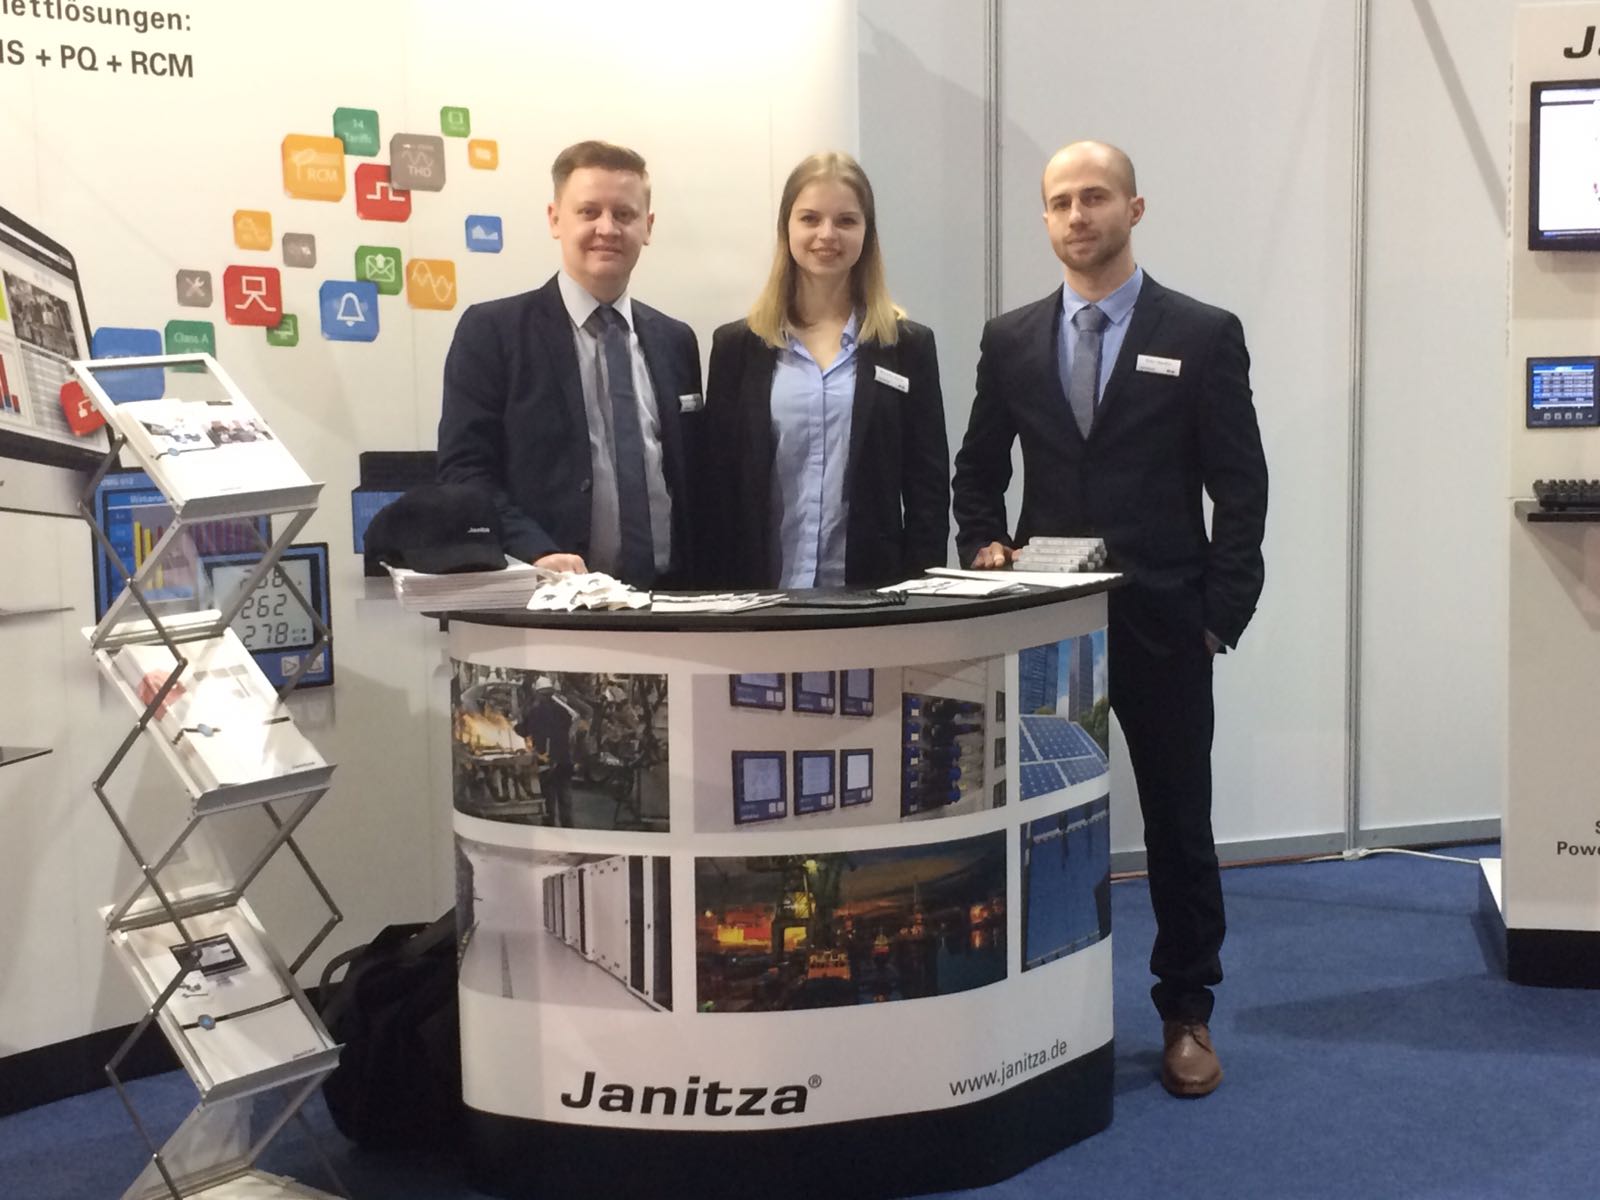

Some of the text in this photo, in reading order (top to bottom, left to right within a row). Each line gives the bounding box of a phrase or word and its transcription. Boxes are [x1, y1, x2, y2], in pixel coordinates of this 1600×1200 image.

[60, 44, 99, 71] PQ
[131, 50, 194, 78] RCM
[307, 167, 338, 183] RCM
[242, 622, 289, 648] 278
[949, 1038, 1068, 1097] www.janitza.de
